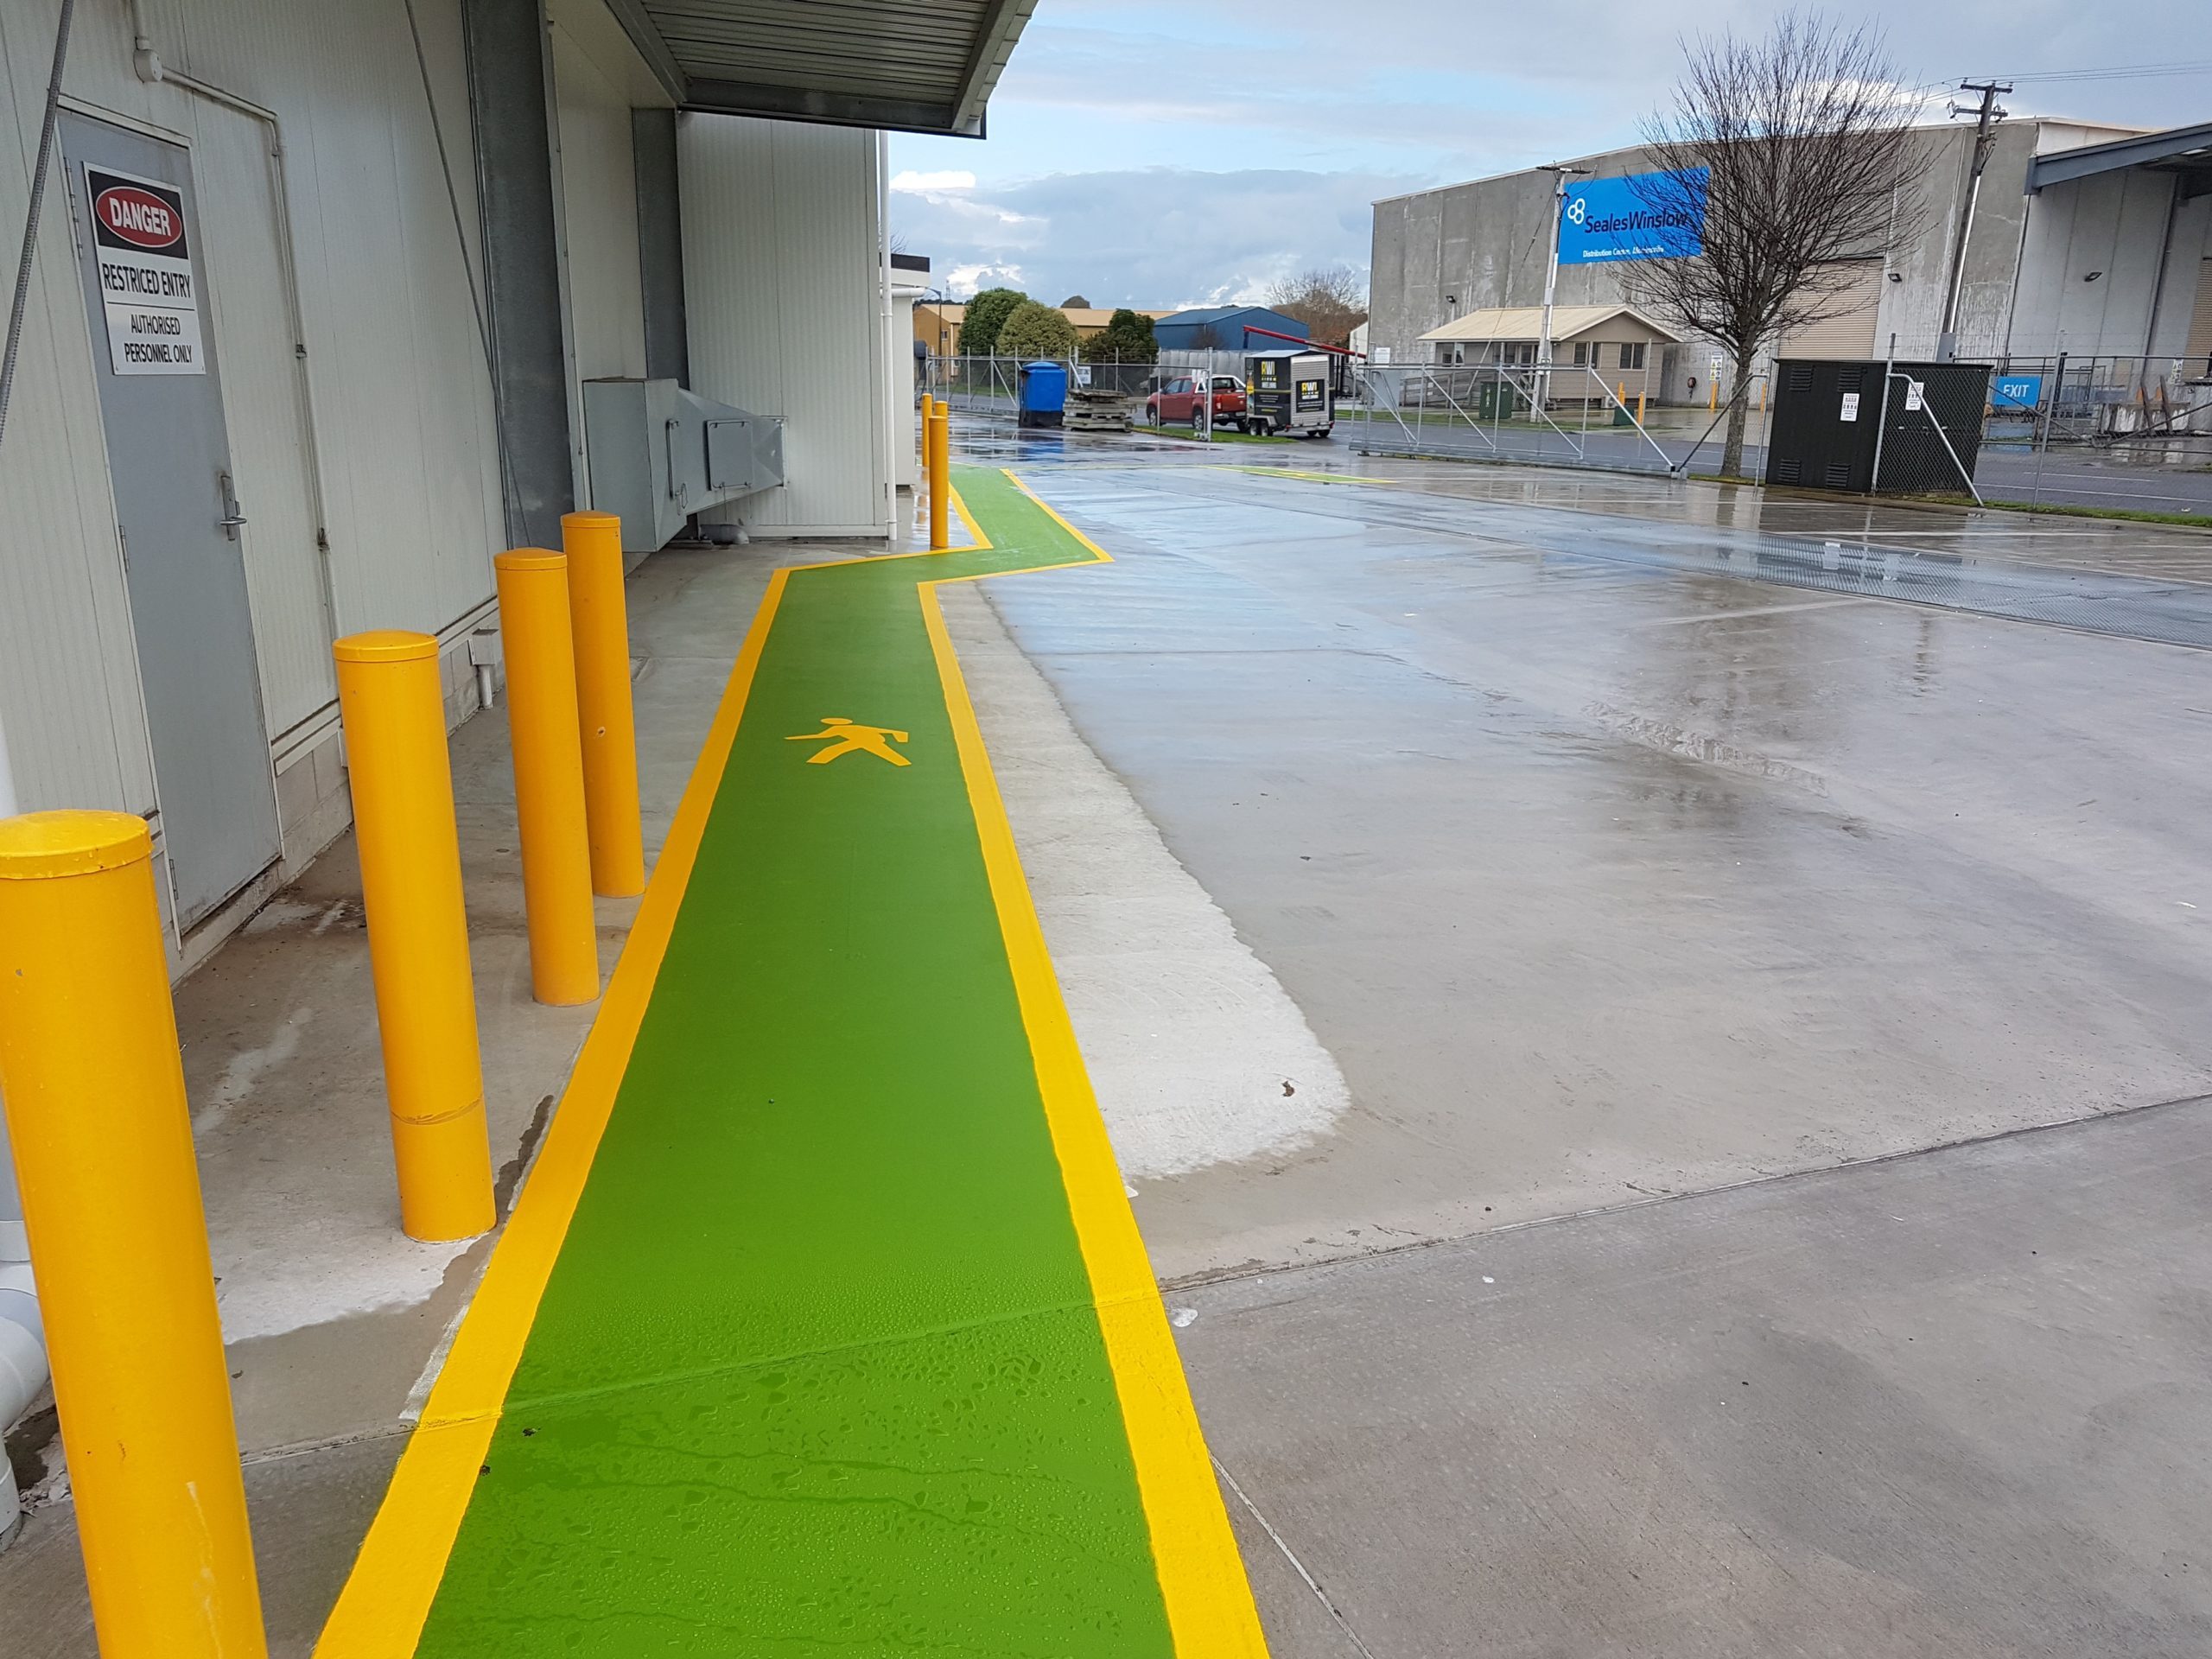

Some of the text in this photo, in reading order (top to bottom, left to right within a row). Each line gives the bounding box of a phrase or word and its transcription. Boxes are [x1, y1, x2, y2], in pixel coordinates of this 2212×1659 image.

[109, 197, 171, 236] DANGER
[102, 263, 191, 298] RESTRICED ENTRY
[130, 314, 181, 335] AUTHORISED
[124, 342, 192, 363] PERSONNEL ONLY
[2004, 385, 2029, 397] EXIT
